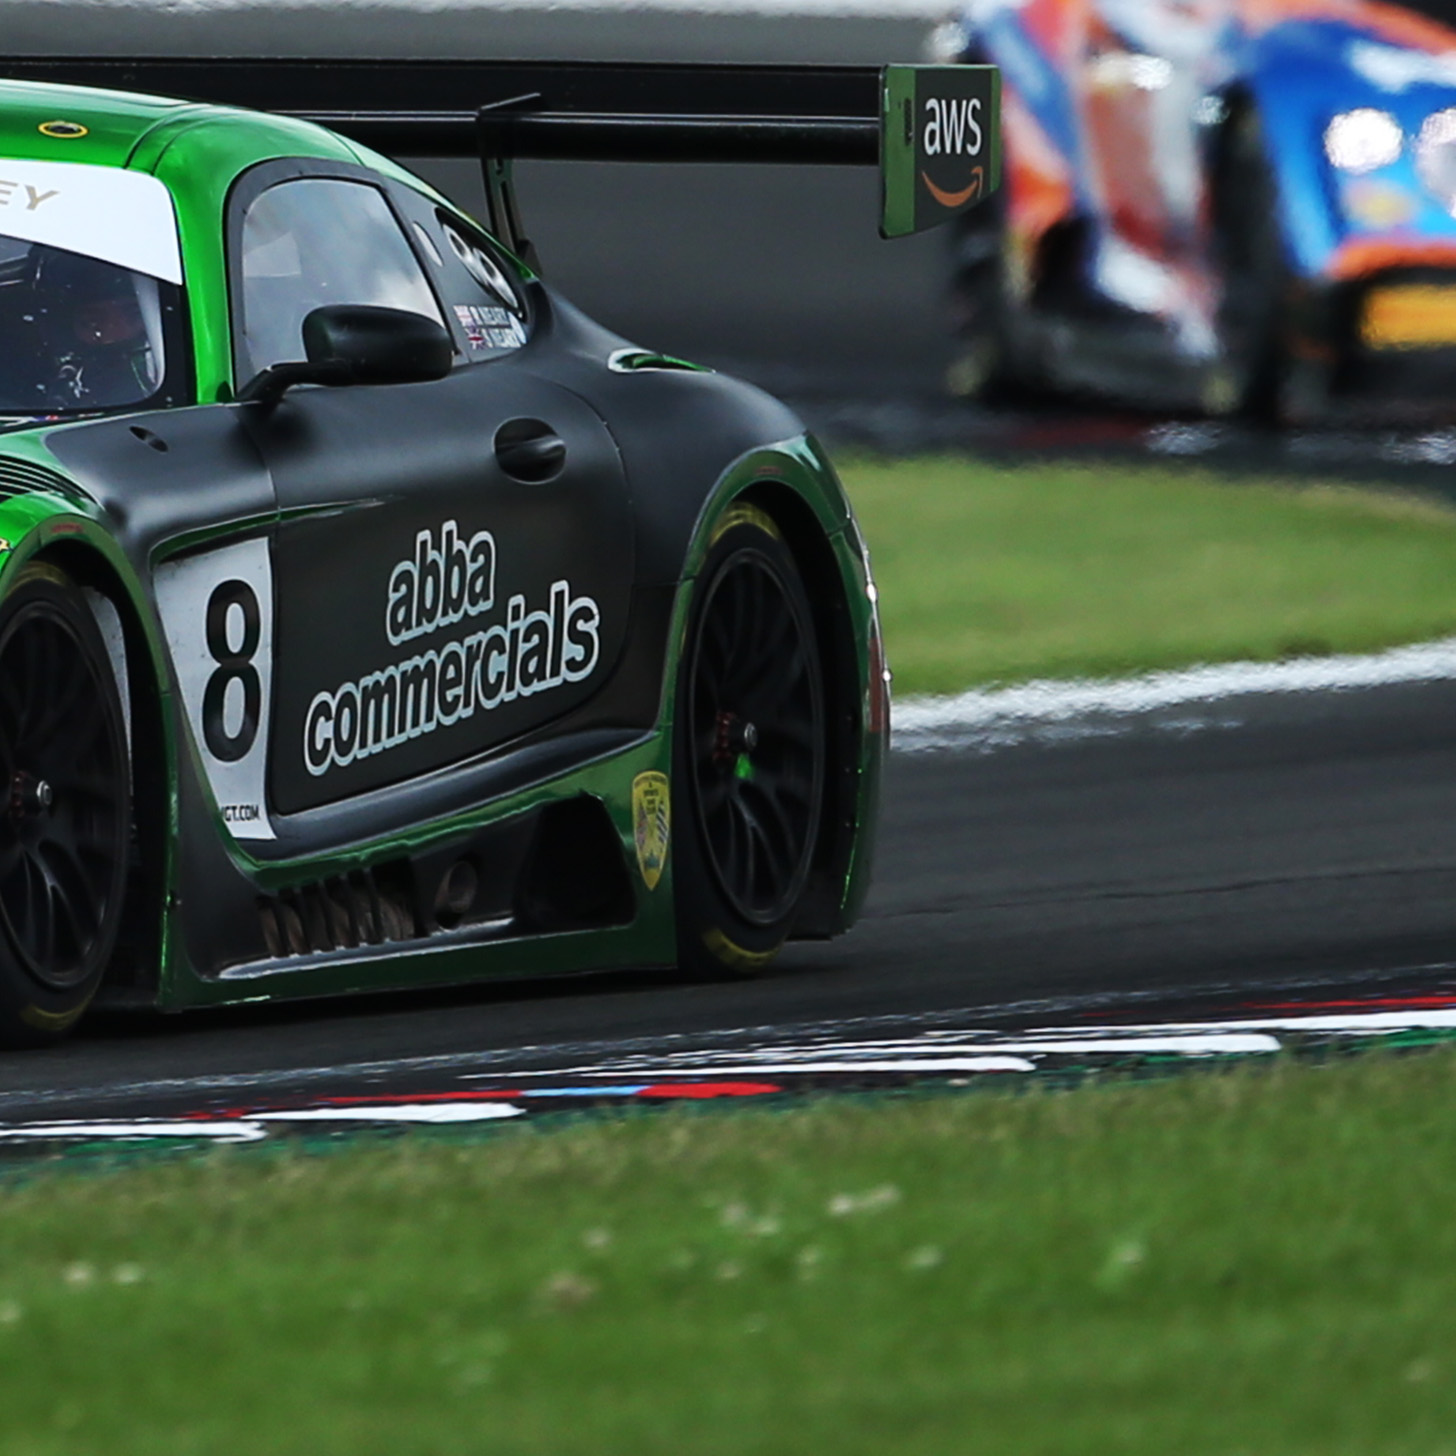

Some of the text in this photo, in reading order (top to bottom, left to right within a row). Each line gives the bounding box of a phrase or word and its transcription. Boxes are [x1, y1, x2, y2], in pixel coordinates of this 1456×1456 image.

[924, 98, 982, 156] aws
[387, 520, 495, 646] abba
[202, 578, 261, 763] 8
[304, 580, 600, 776] commercials
